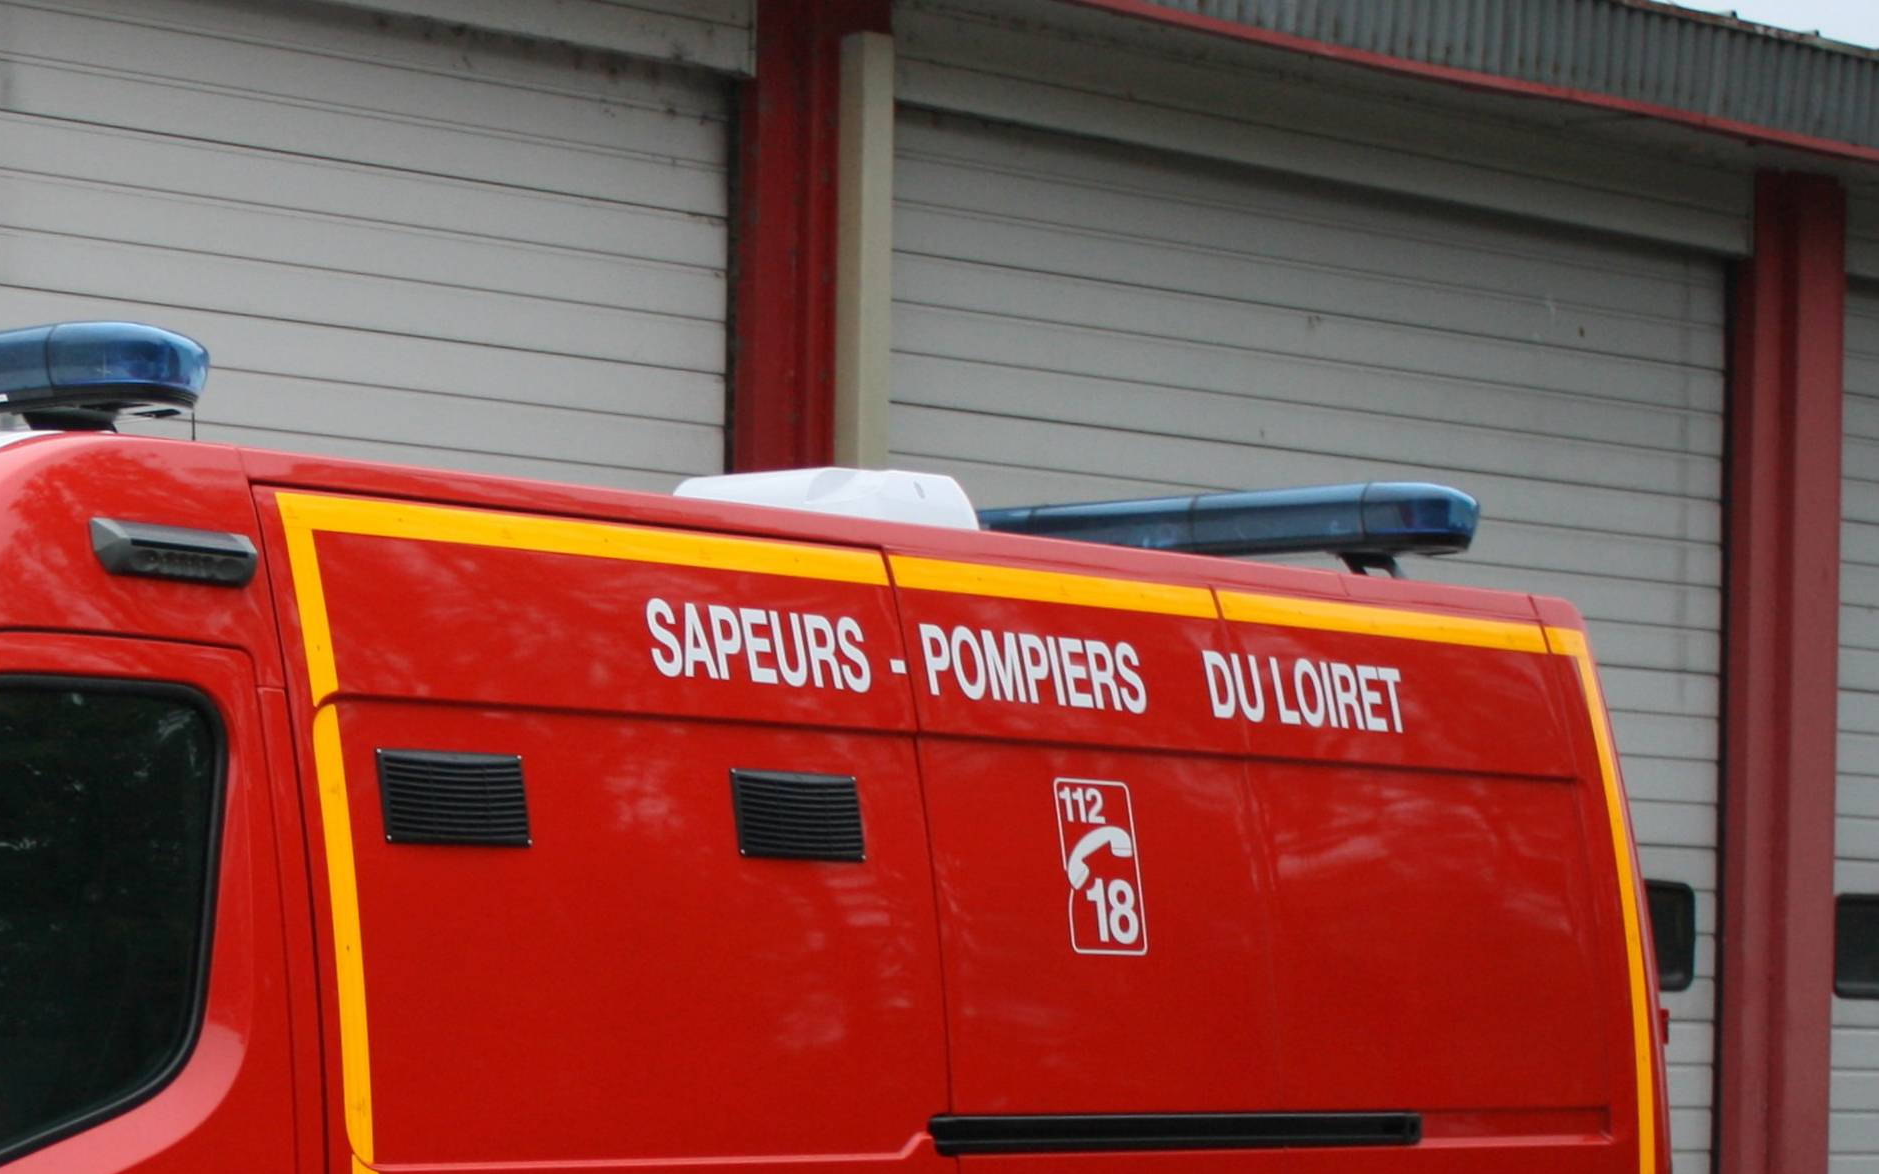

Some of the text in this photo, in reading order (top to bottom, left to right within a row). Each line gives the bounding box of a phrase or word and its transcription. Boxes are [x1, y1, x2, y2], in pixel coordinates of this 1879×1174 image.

[645, 597, 872, 693] SAPEURS
[918, 623, 1148, 715] POMPIERS
[1201, 649, 1266, 723] DU
[1273, 656, 1405, 734] LOIRET
[1058, 787, 1106, 826] 112
[1086, 878, 1140, 945] 18
